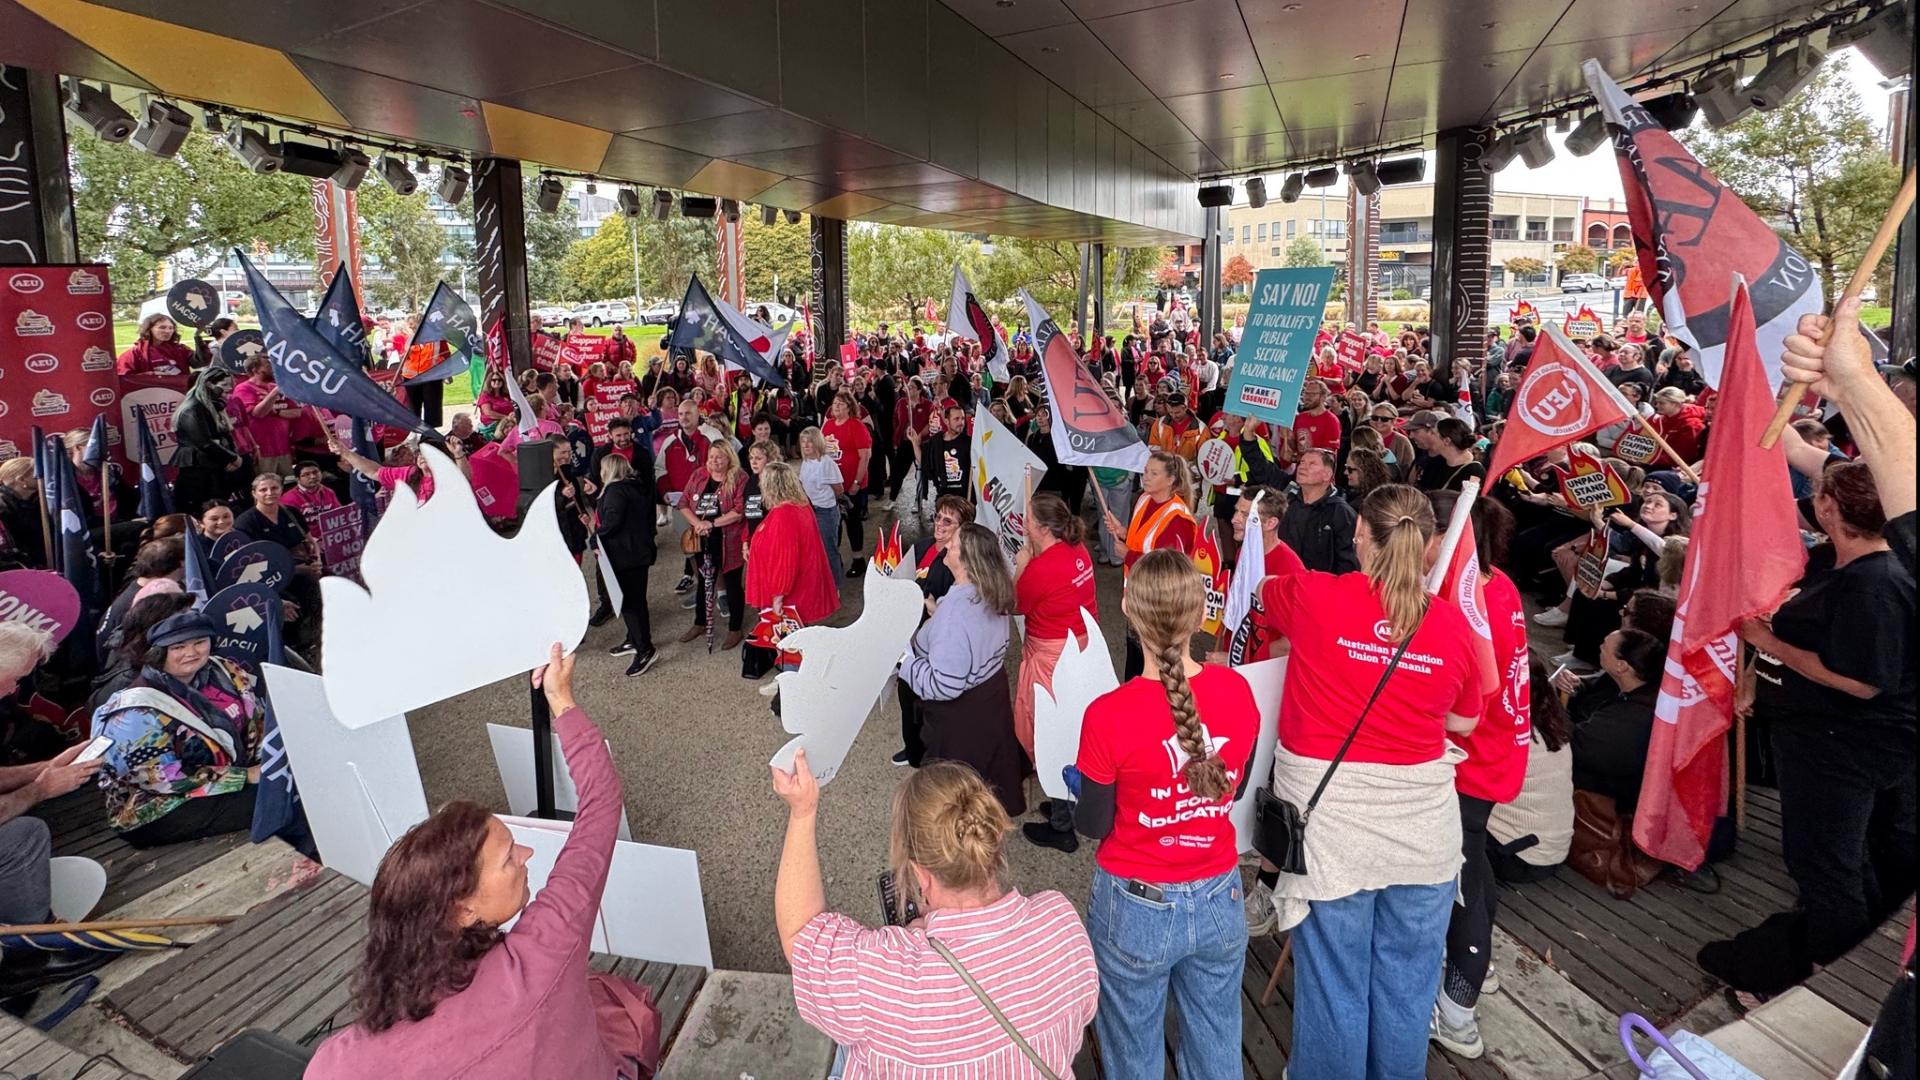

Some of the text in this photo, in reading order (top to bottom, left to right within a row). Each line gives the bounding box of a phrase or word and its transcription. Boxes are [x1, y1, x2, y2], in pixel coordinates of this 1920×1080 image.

[14, 279, 39, 287] AEU
[1260, 283, 1321, 307] SAY NO!
[81, 317, 103, 325] AEU
[1251, 313, 1316, 330] TO ROCKLIFF'S
[569, 335, 602, 346] Support
[1258, 331, 1293, 346] PUBLIC
[1253, 346, 1288, 364] SECTOR
[30, 359, 54, 368] AEU
[1240, 362, 1299, 383] RAZOR GANG!
[596, 383, 632, 394] Support
[1244, 386, 1270, 397] WE ARE
[1241, 394, 1278, 407] ESSENTIAL
[1621, 440, 1654, 453] STAFFING
[1627, 434, 1655, 446] SCHOOL
[1566, 473, 1604, 488] UNPAID
[1574, 483, 1607, 497] STAND
[1578, 491, 1613, 505] DOWN
[326, 513, 347, 530] WE
[327, 529, 352, 547] FOR
[1337, 637, 1444, 666] Australian Eucation
[1348, 650, 1379, 664] Union
[1150, 786, 1171, 801] IN
[1138, 800, 1234, 829] EDUCATIO
